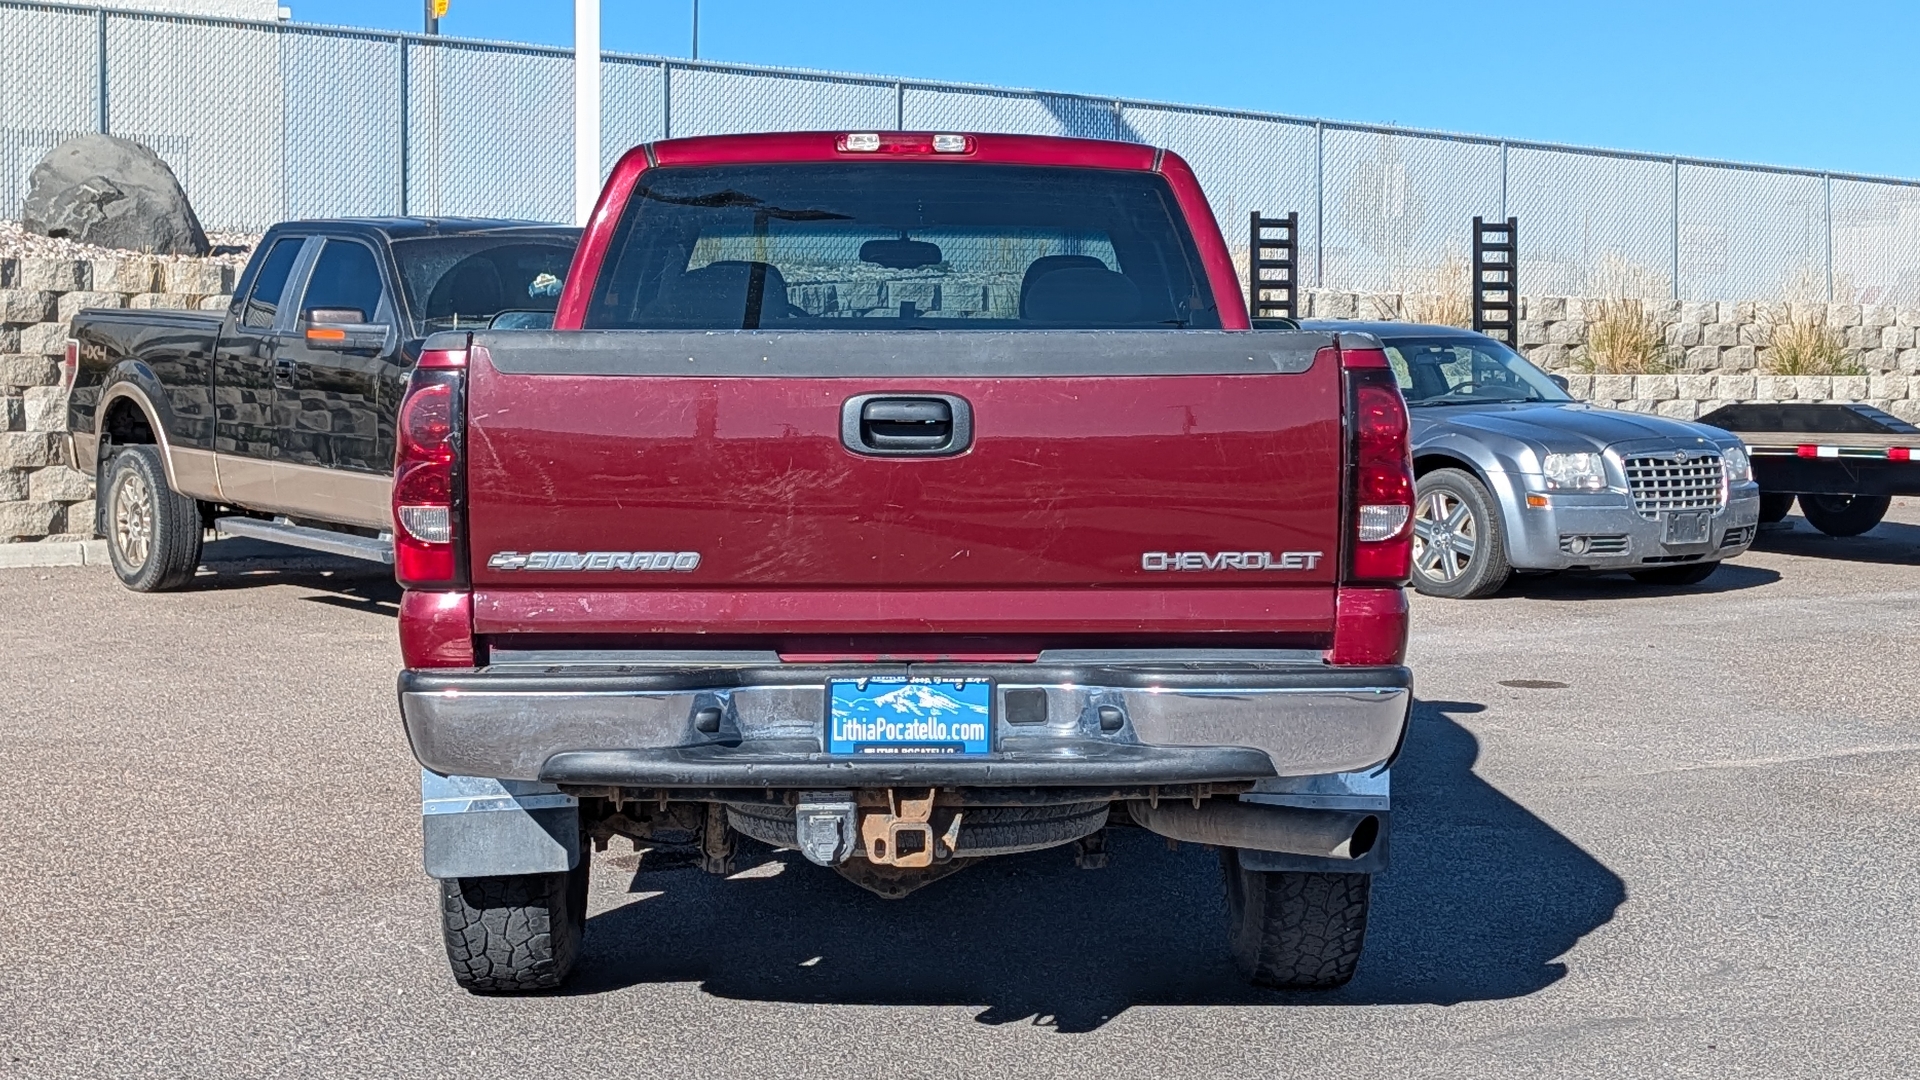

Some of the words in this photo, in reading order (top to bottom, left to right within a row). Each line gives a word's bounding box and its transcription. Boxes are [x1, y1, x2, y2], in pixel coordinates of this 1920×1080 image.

[524, 552, 701, 572] SILVERADO
[1142, 551, 1323, 570] CHEVROLET
[833, 717, 985, 741] LithiaPocatello.com
